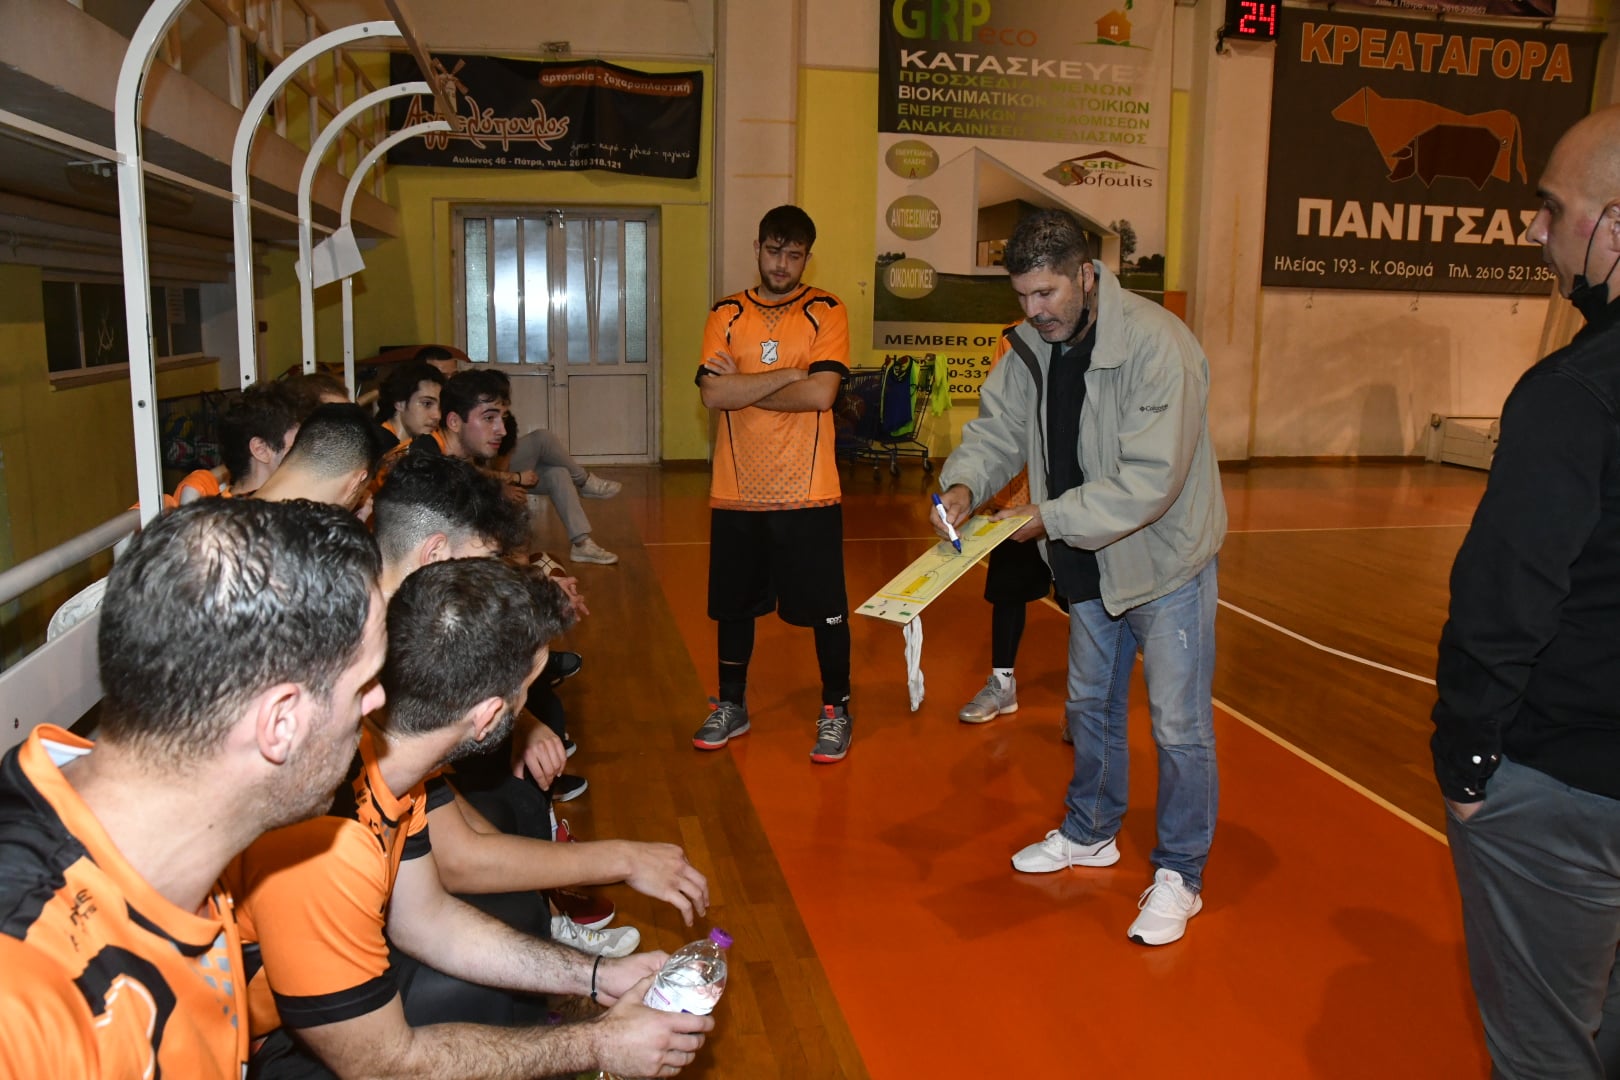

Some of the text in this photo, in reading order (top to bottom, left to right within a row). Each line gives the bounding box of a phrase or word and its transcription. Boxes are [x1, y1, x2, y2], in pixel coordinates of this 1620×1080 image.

[892, 0, 1038, 47] GRP eco
[1239, 1, 1275, 36] 24
[1301, 22, 1573, 83] ΚΡΕΑΤΑΓΟΡΑ
[898, 85, 1048, 108] ΒΙΟΚΛΙΜΑΤΙΚΩΝ
[897, 103, 1016, 121] ΕΝΕΡΓΕΙΑΚΩΝ
[495, 157, 507, 165] 46
[1082, 160, 1127, 170] GRP
[1297, 198, 1543, 247] ΠΑΝΙΤΣΑΣ
[1274, 255, 1326, 275] Ηλείας
[1333, 258, 1357, 273] 193
[1448, 262, 1473, 279] Τηλ.
[1476, 266, 1504, 280] 2610
[884, 334, 997, 347] MEMBER OF
